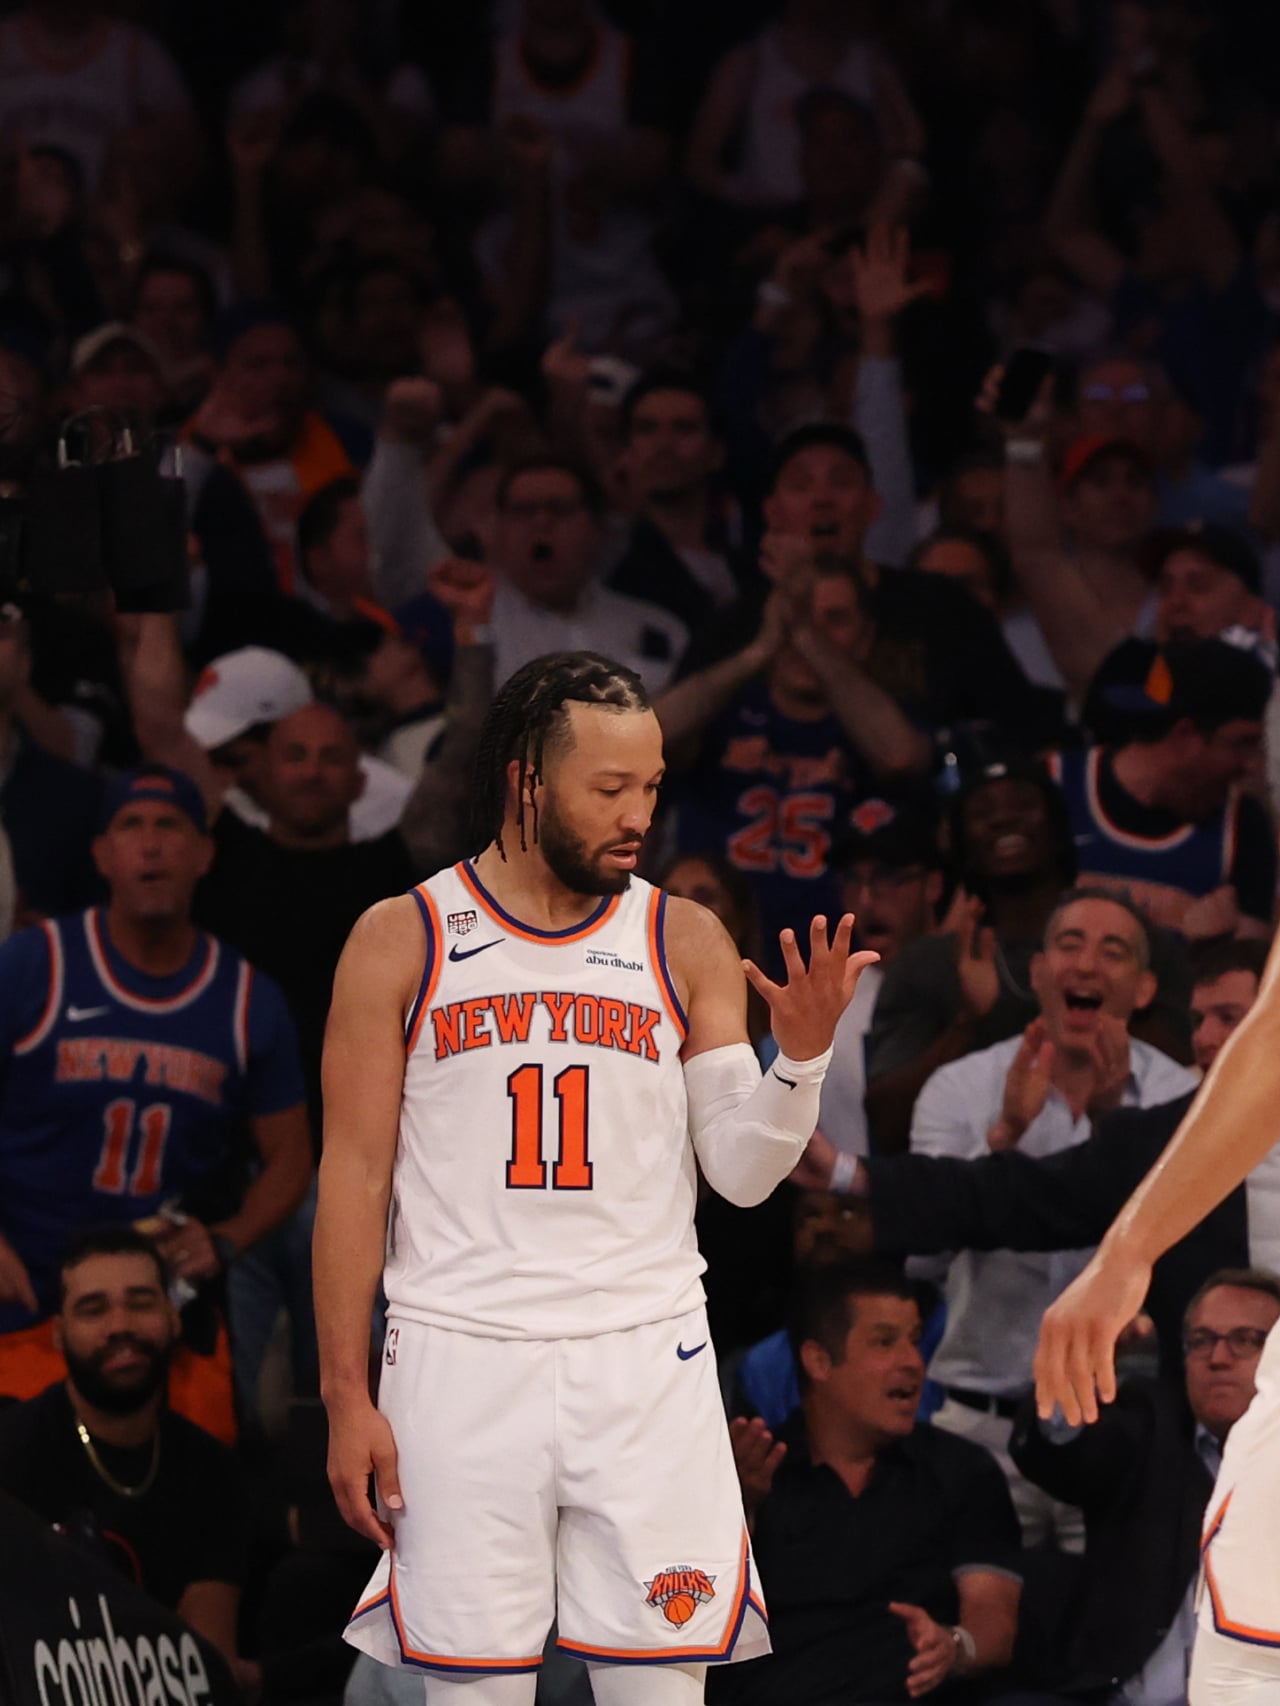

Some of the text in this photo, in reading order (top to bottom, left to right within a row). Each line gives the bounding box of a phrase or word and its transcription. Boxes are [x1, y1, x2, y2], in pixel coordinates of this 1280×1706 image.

[727, 784, 836, 880] 25
[586, 956, 643, 971] abu dhabi
[55, 1036, 141, 1083] NEW
[432, 992, 660, 1063] NEW YORK
[92, 1097, 172, 1197] 11
[506, 1063, 593, 1190] 11
[646, 1569, 714, 1601] KNICKS
[34, 1593, 211, 1706] coinbase
